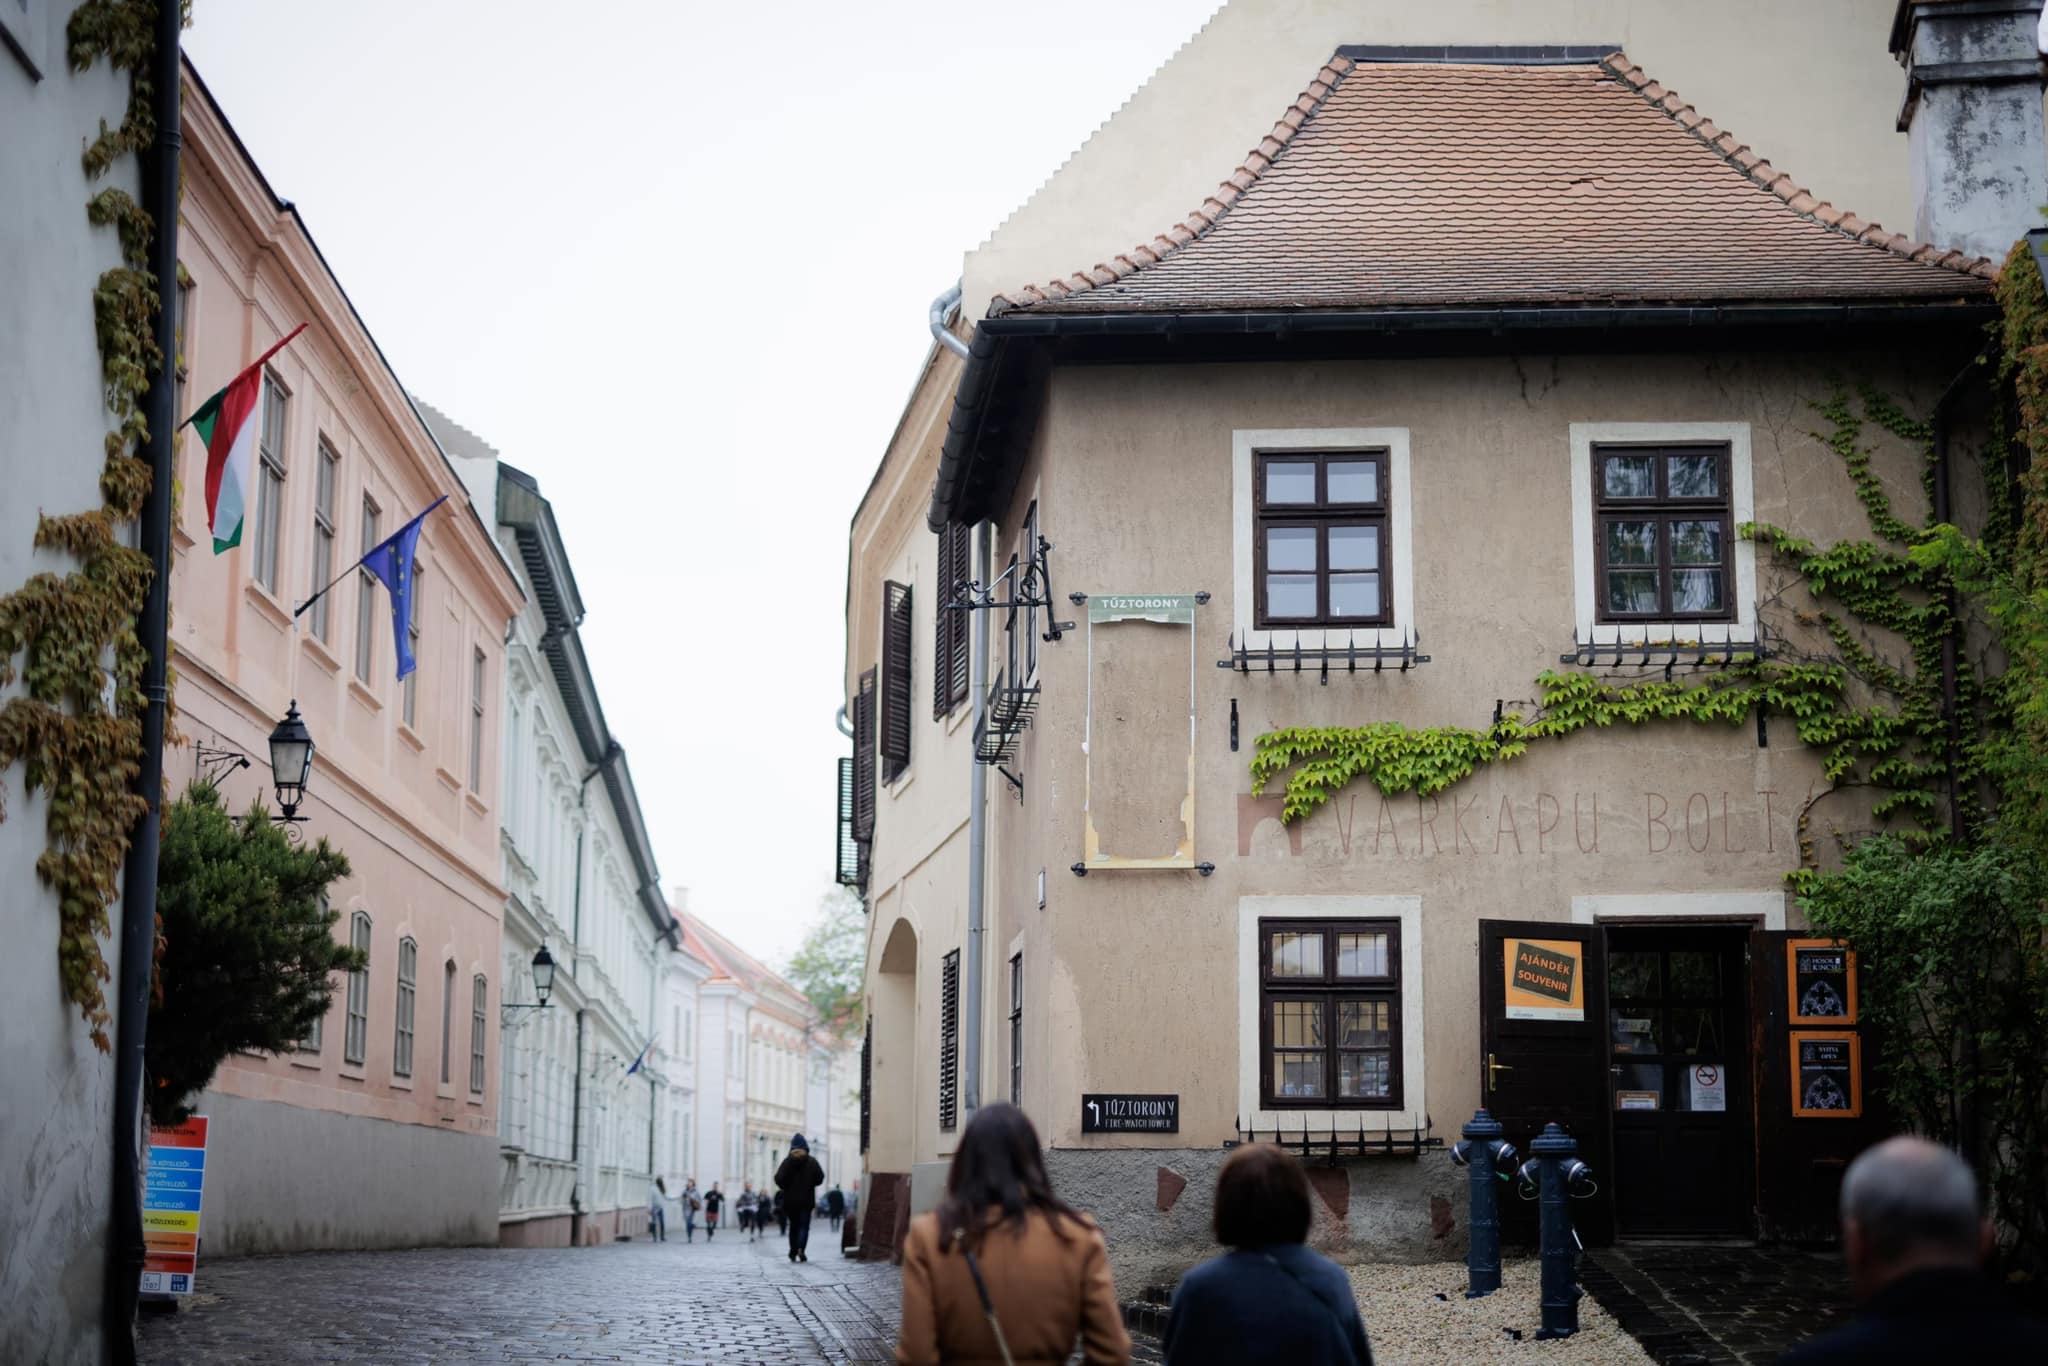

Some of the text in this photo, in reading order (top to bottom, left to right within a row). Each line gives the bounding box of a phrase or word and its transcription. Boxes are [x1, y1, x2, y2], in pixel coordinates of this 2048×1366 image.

[1102, 596, 1180, 609] TŰZTORONY
[1644, 790, 1779, 854] BOLT
[1520, 952, 1570, 976] AJÁNDÉK
[1518, 969, 1568, 993] SOUVENIR
[1104, 1099, 1175, 1116] TŰZTORONY
